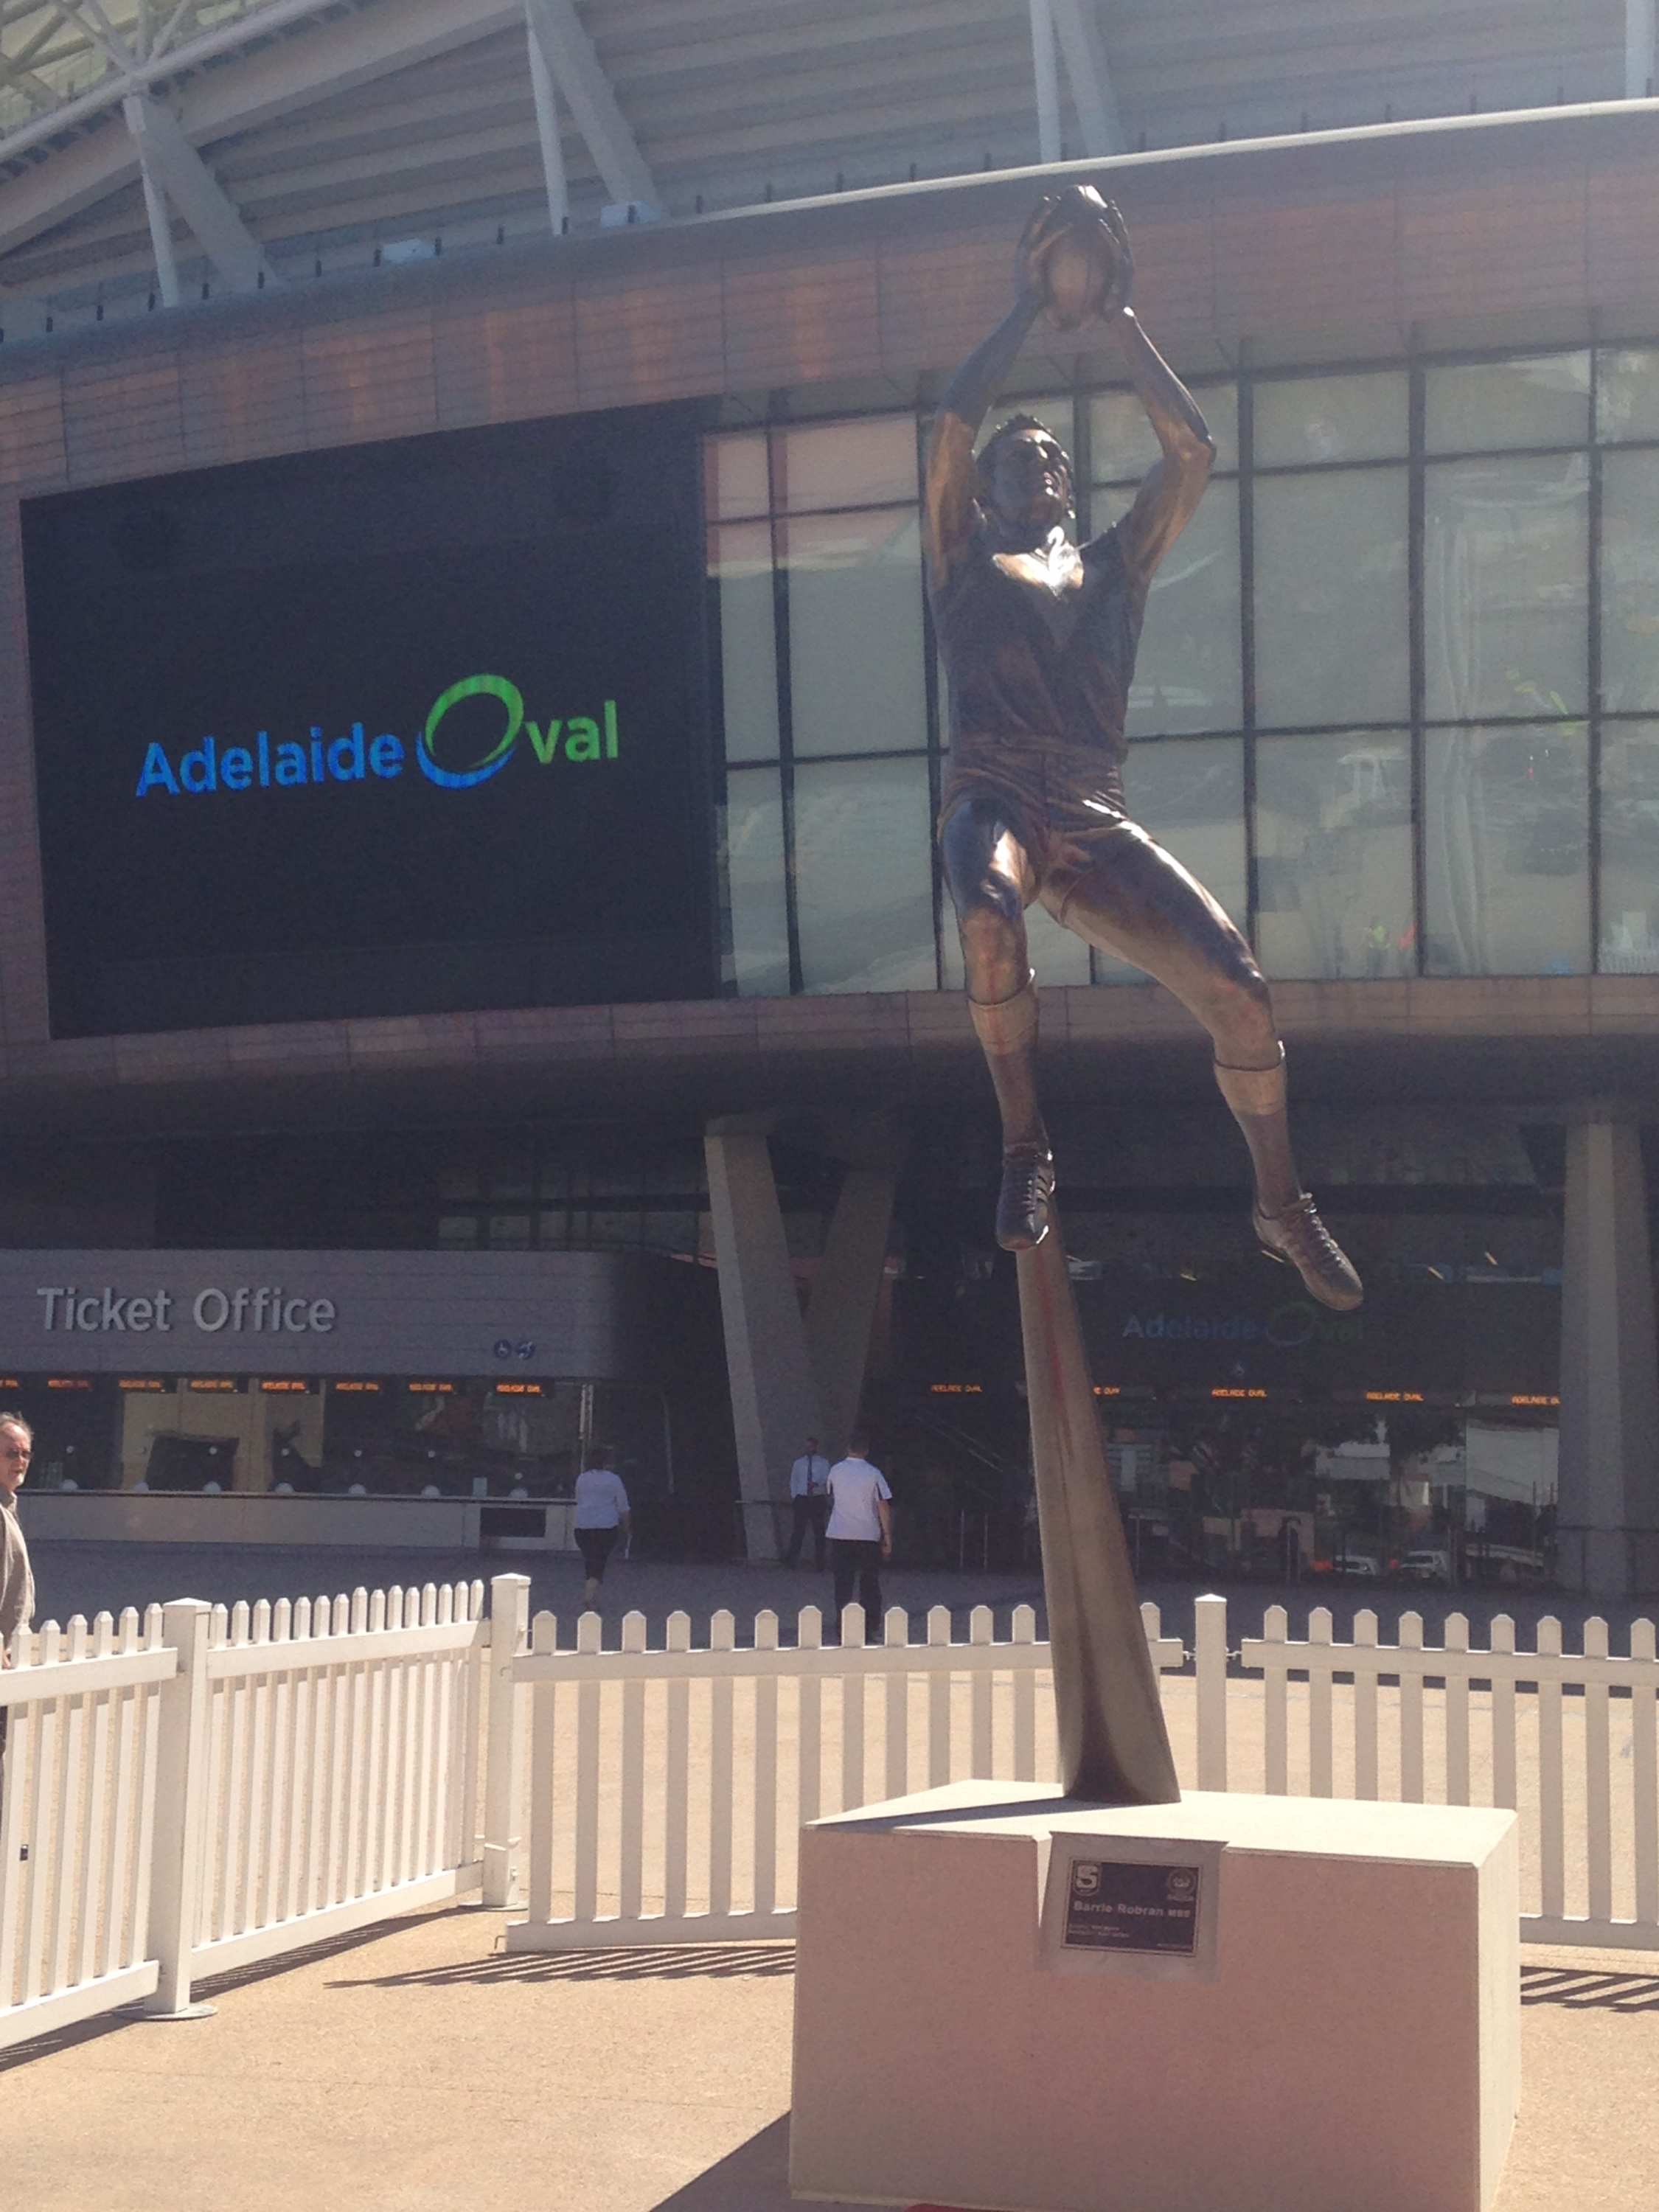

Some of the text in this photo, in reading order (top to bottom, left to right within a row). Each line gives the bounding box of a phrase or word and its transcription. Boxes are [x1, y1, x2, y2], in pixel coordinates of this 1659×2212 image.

[136, 674, 619, 796] Adelaide Oval
[36, 1286, 336, 1332] Ticket Office
[1074, 1900, 1113, 1913] Barrie
[1118, 1903, 1164, 1916] Robran
